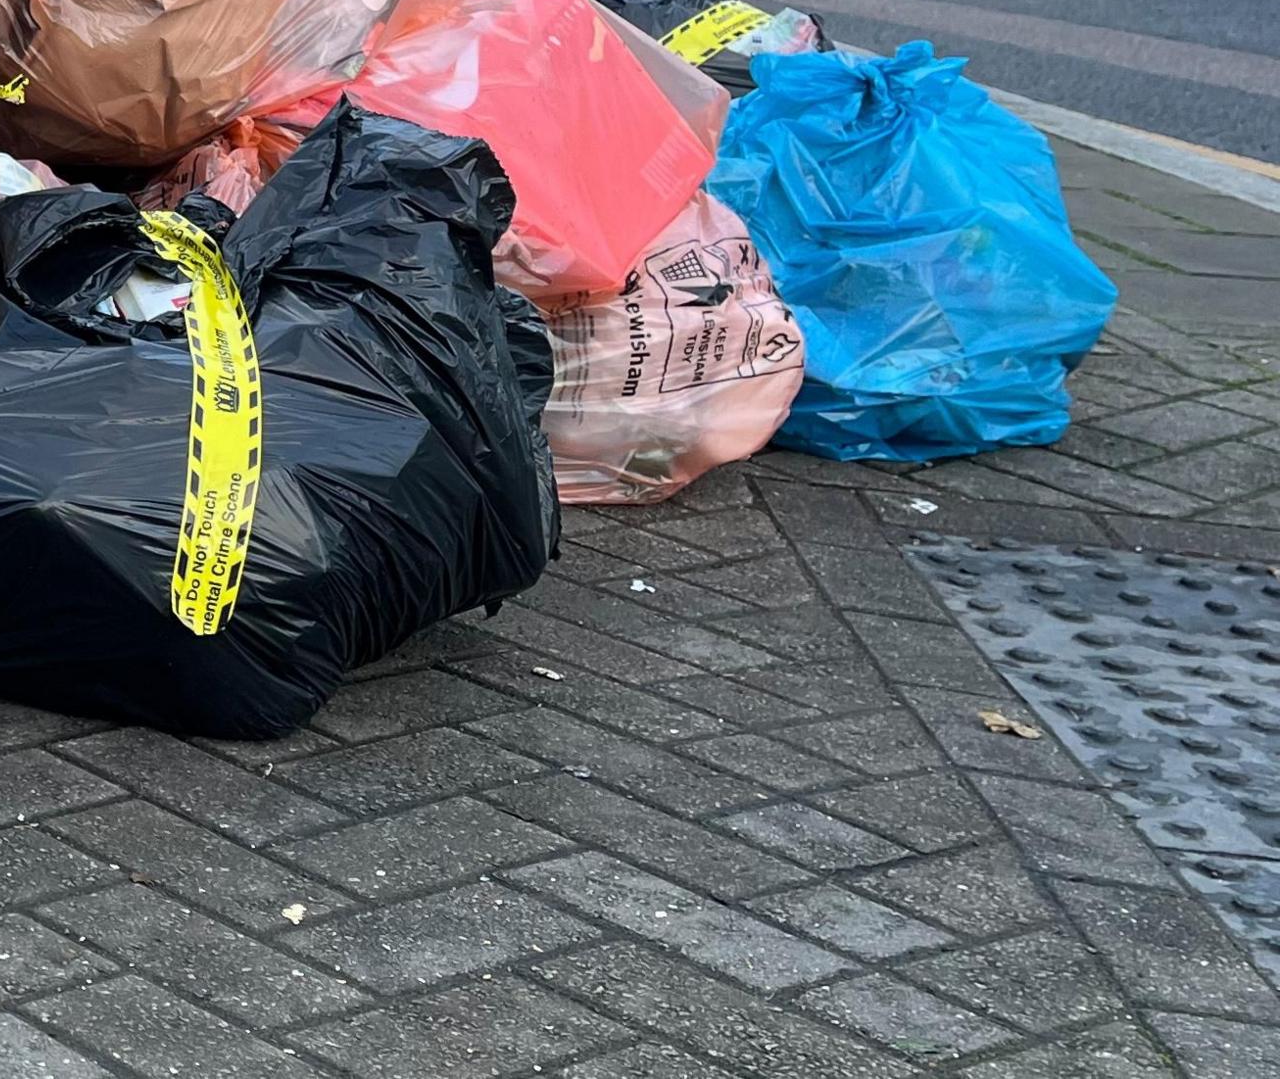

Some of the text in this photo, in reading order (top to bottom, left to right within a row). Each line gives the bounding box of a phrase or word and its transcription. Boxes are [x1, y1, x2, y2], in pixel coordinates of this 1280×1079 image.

[683, 332, 698, 364] TIDY
[692, 309, 714, 382] LEWISHAM
[713, 325, 727, 362] KEEP
[186, 490, 218, 601] Do Not Touch
[211, 529, 233, 577] Crime
[222, 472, 242, 524] Scene
